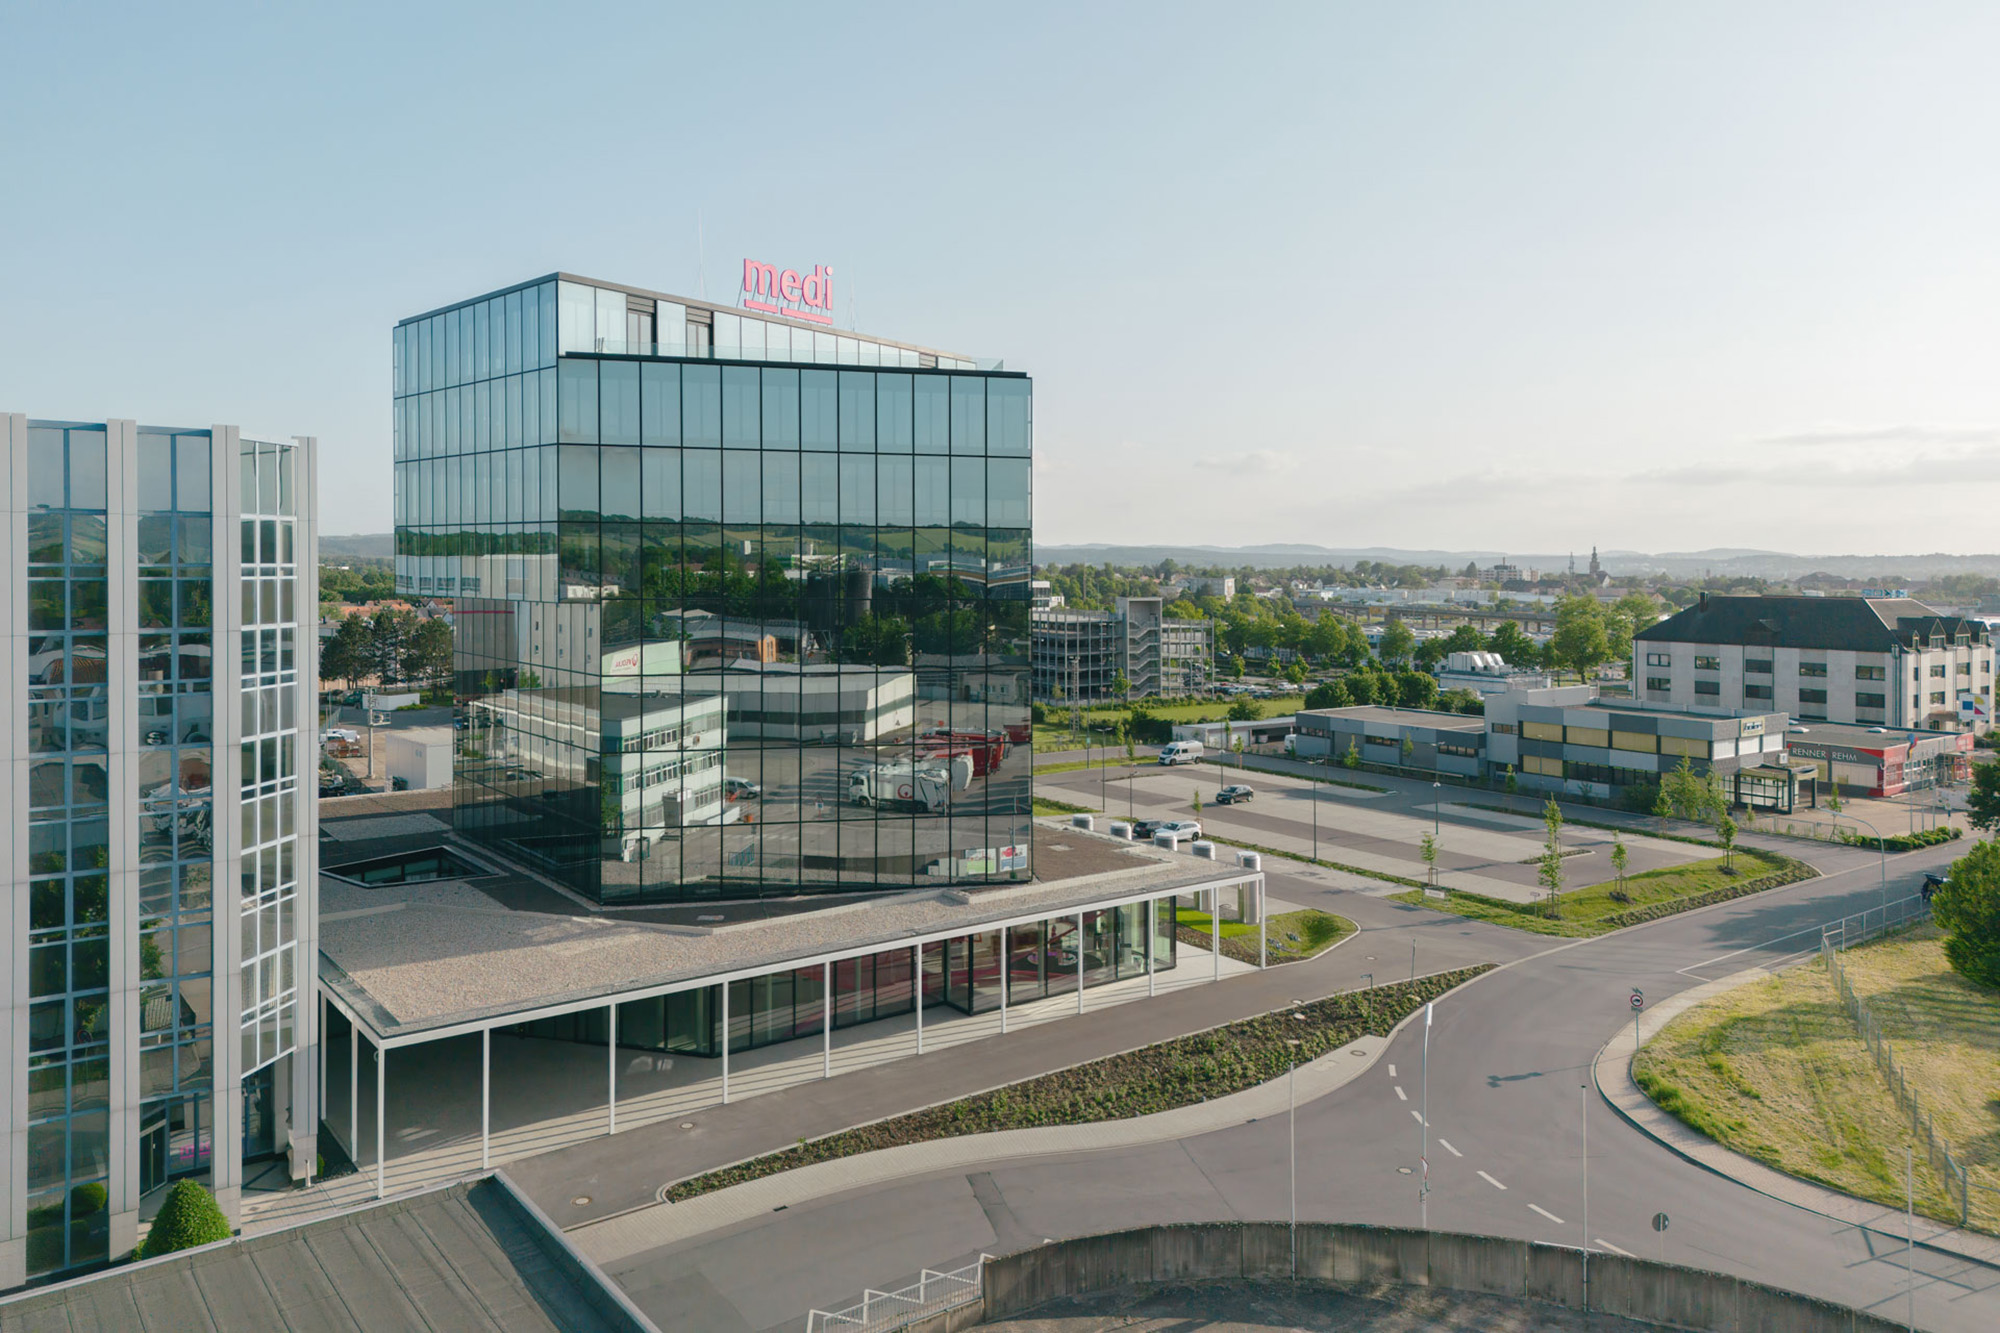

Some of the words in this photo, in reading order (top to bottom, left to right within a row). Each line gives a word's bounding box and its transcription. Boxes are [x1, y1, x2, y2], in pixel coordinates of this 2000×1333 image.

[743, 258, 833, 310] medi
[1792, 747, 1826, 758] RENNER
[1832, 751, 1857, 761] REHM
